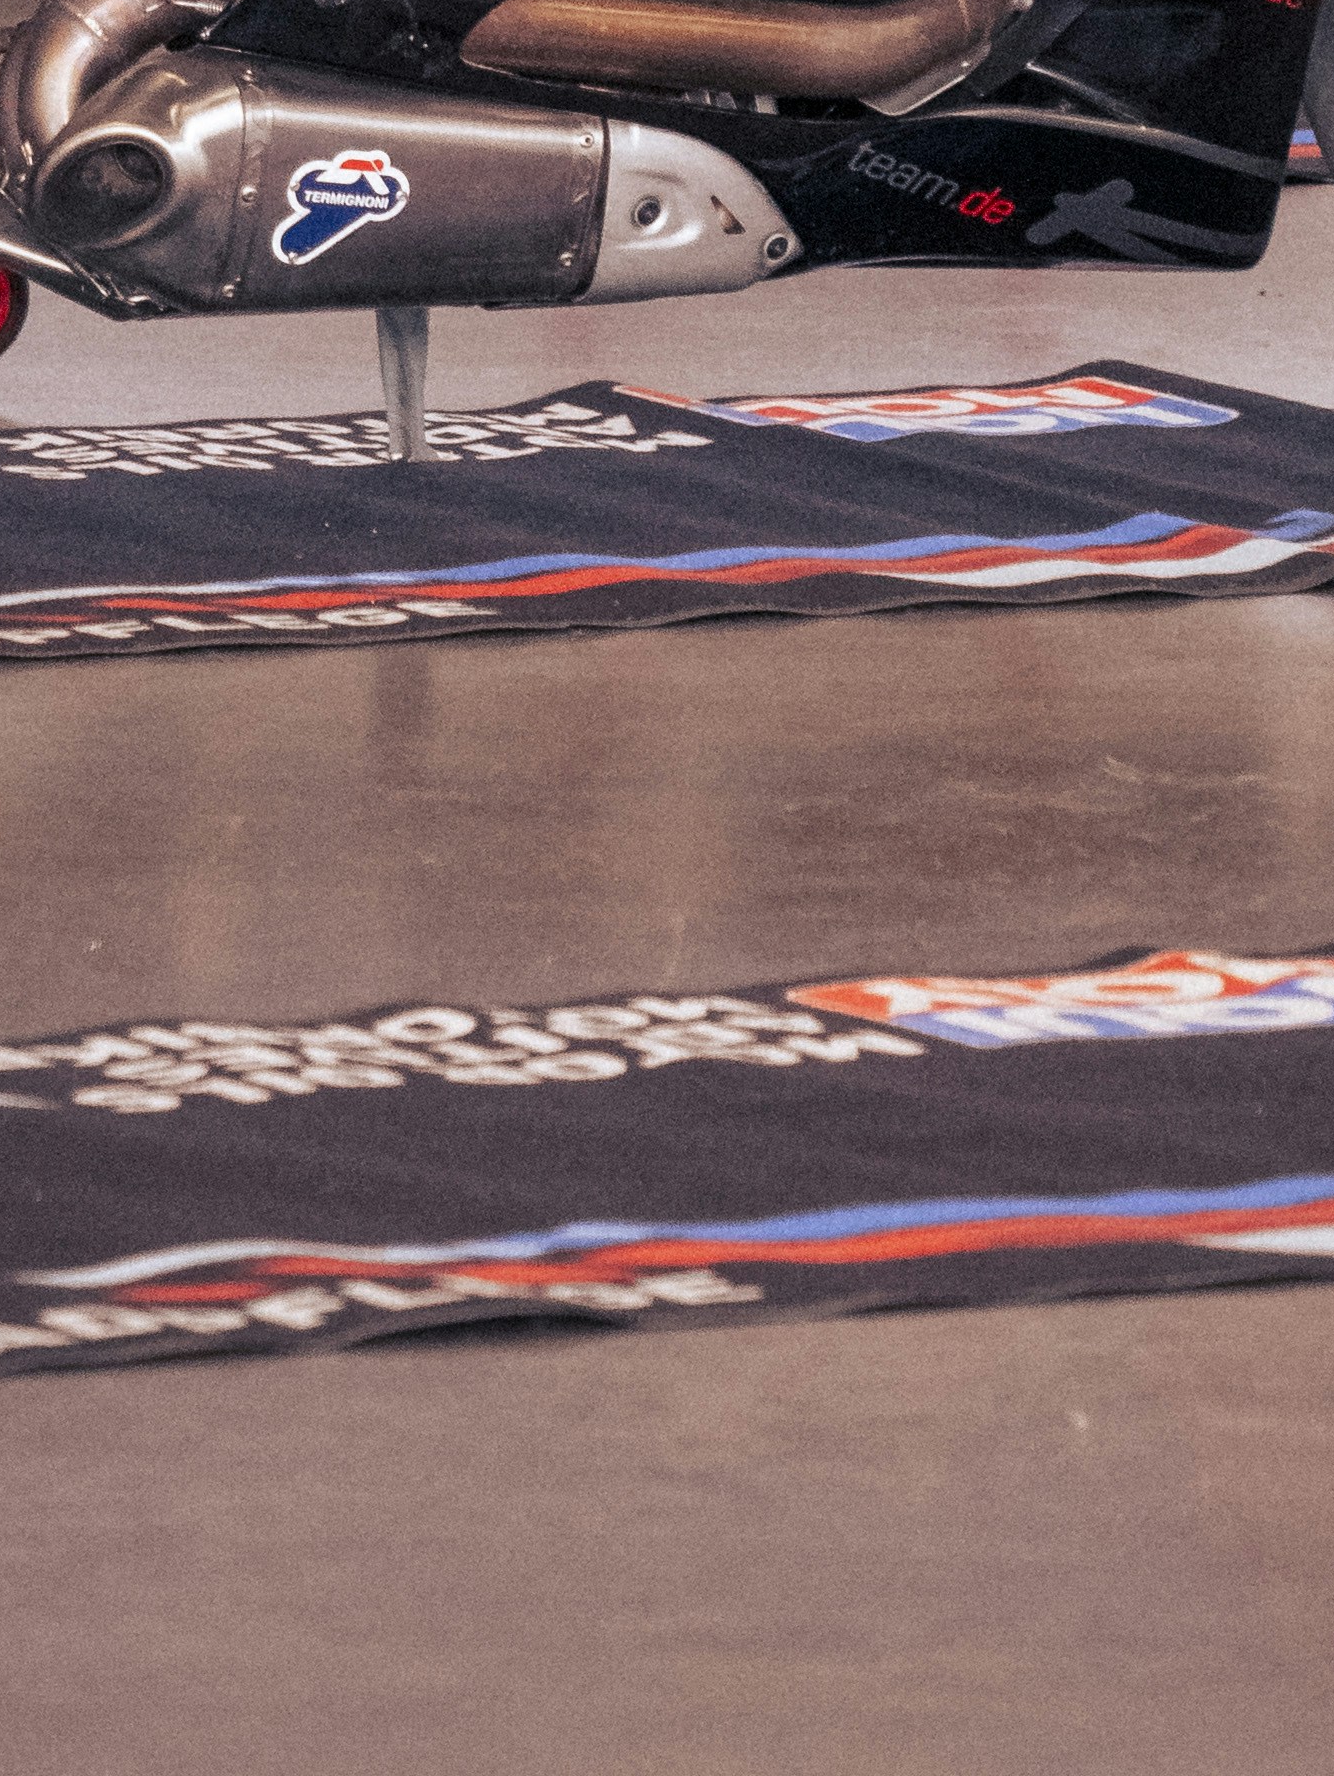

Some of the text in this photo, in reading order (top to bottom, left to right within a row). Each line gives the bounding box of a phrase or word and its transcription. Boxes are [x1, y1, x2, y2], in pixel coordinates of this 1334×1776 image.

[303, 190, 390, 210] TERMIGNONI
[847, 141, 1017, 225] team.de
[32, 414, 637, 464] ADDTIVES
